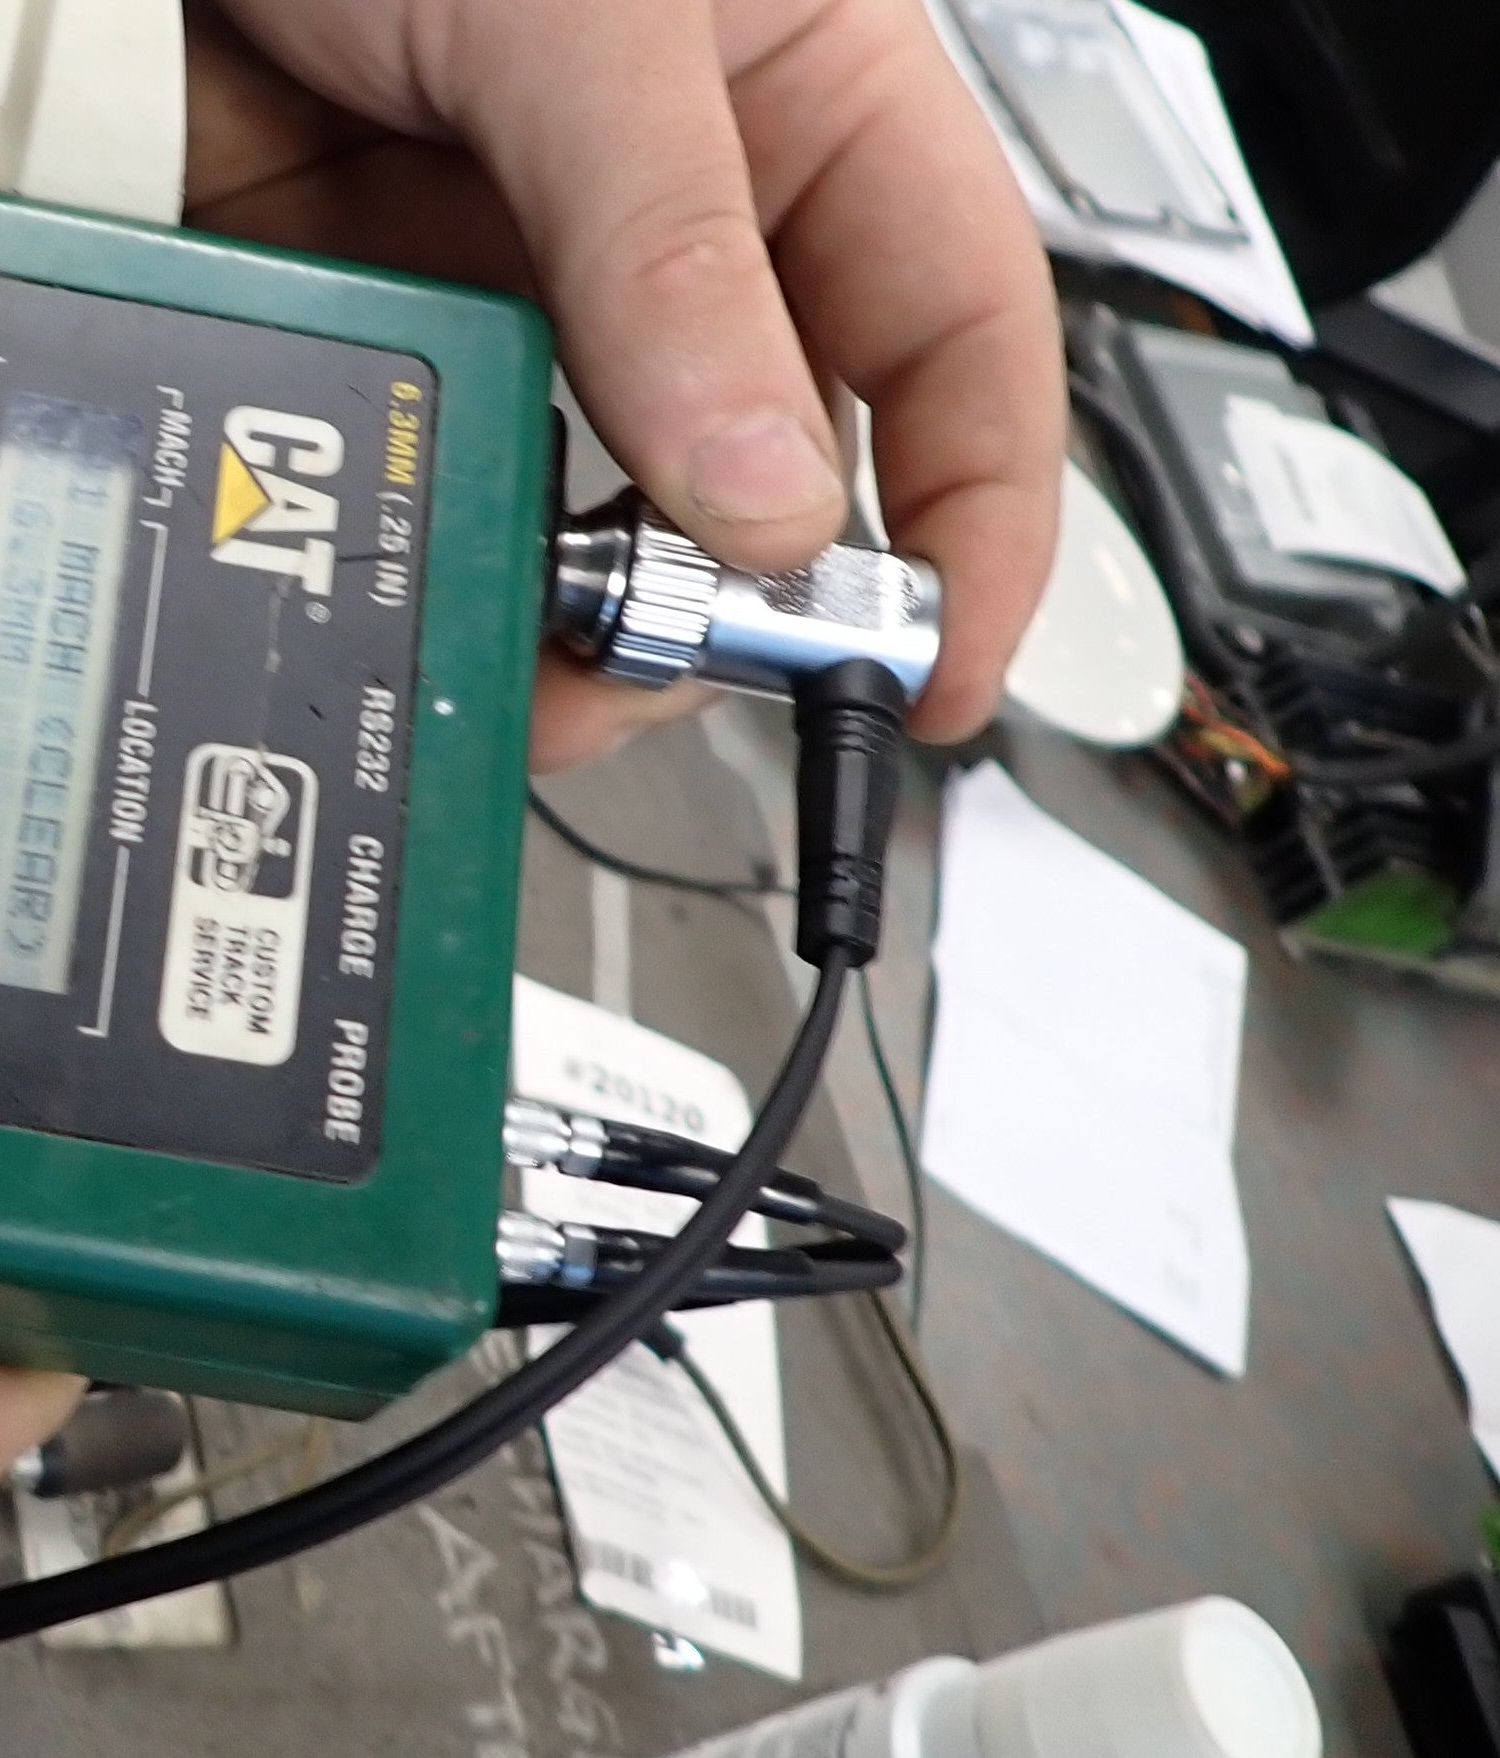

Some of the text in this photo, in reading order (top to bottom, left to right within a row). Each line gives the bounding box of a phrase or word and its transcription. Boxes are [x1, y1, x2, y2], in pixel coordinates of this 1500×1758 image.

[153, 407, 193, 488] MACH
[384, 381, 423, 486] 6.3MM
[209, 404, 346, 598] CAT
[43, 539, 102, 675] MACH
[109, 699, 160, 844] LOCATION
[353, 685, 398, 794] RS232
[338, 833, 386, 981] CHARGE
[185, 915, 219, 1021] SERVICE
[218, 924, 252, 1005] TRACK
[247, 927, 282, 1035] CUSTOM
[323, 1017, 370, 1147] PROBE
